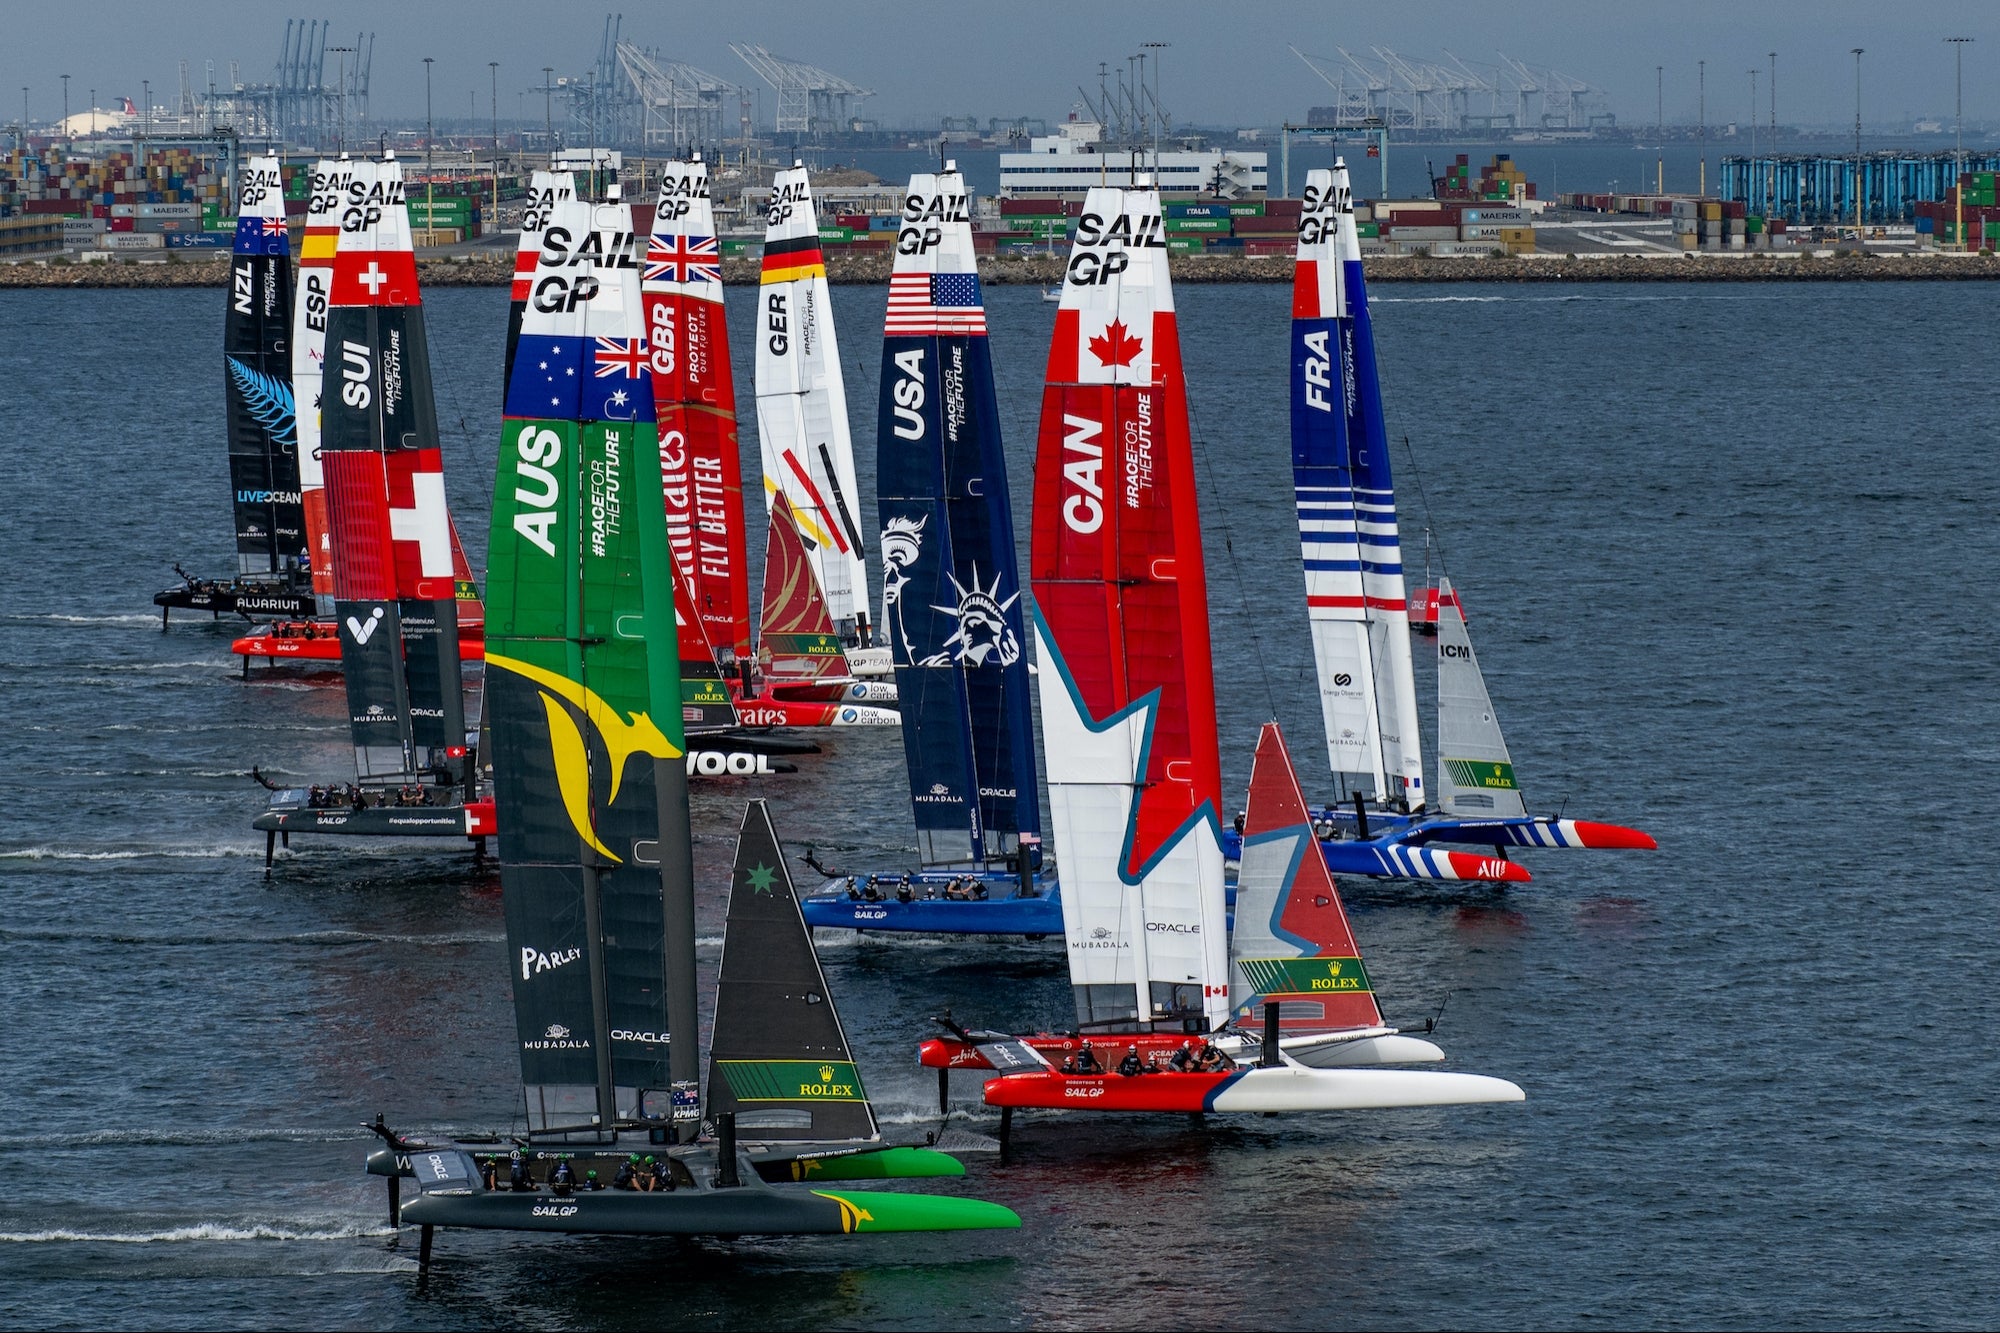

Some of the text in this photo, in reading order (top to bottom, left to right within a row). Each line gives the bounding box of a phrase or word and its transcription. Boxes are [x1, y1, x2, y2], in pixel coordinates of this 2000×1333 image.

[245, 169, 281, 188] SAIL
[661, 176, 711, 199] SAIL
[242, 189, 266, 206] GP
[308, 196, 338, 214] GP
[347, 181, 406, 206] SAIL
[770, 182, 810, 206] SAIL
[1302, 185, 1353, 213] SAIL
[342, 208, 381, 232] GP
[657, 200, 690, 221] GP
[767, 206, 793, 226] GP
[903, 195, 969, 222] SAIL
[897, 228, 942, 255] GP
[1075, 213, 1167, 247] SAIL
[1299, 217, 1337, 244] GP
[539, 226, 638, 268] SAIL
[1068, 252, 1130, 286] GP
[235, 262, 252, 315] NZL
[533, 276, 600, 313] GP
[306, 275, 326, 333] ESP
[808, 289, 817, 343] THEFUTURE
[769, 293, 788, 356] GER
[651, 302, 675, 375] GBR
[689, 312, 699, 384] PROTECT
[699, 306, 708, 373] OUR FUTURE
[343, 340, 371, 409] SUI
[391, 329, 402, 400] THEFUTURE
[1304, 331, 1331, 412] FRA
[384, 350, 395, 415] #RACEFOR
[894, 349, 925, 441] USA
[952, 346, 965, 425] THEFUTURE
[945, 369, 957, 442] #RACEFOR
[1138, 393, 1152, 488] THEFUTURE
[1063, 413, 1104, 534] CAN
[1125, 420, 1139, 508] #RACEFOR
[513, 425, 562, 557] AUS
[605, 428, 620, 536] THEFUTURE
[591, 459, 605, 557] #RACEFOR
[693, 456, 730, 577] FLY BETTER
[703, 614, 733, 623] ORACLE
[808, 646, 837, 654] ROLEX
[1440, 645, 1470, 658] ICM
[694, 693, 725, 701] ROLEX
[870, 684, 888, 693] low
[870, 691, 899, 700] carbo
[409, 708, 444, 717] ORACLE
[861, 708, 879, 717] low
[861, 716, 896, 725] carbon
[1329, 739, 1367, 747] MUBADALA
[979, 787, 1017, 798] ORACLE
[1485, 777, 1512, 787] ROLEX
[915, 795, 964, 803] MUBADALA
[1146, 922, 1200, 934] ORACLE
[1072, 941, 1129, 949] MUBADALA
[1311, 978, 1359, 989] ROLEX
[524, 1039, 590, 1050] MUBADALA
[610, 1029, 670, 1044] ORACLE
[800, 1084, 853, 1096] ROLEX
[673, 1109, 700, 1119] KPMG
[796, 1152, 825, 1160] POWERED
